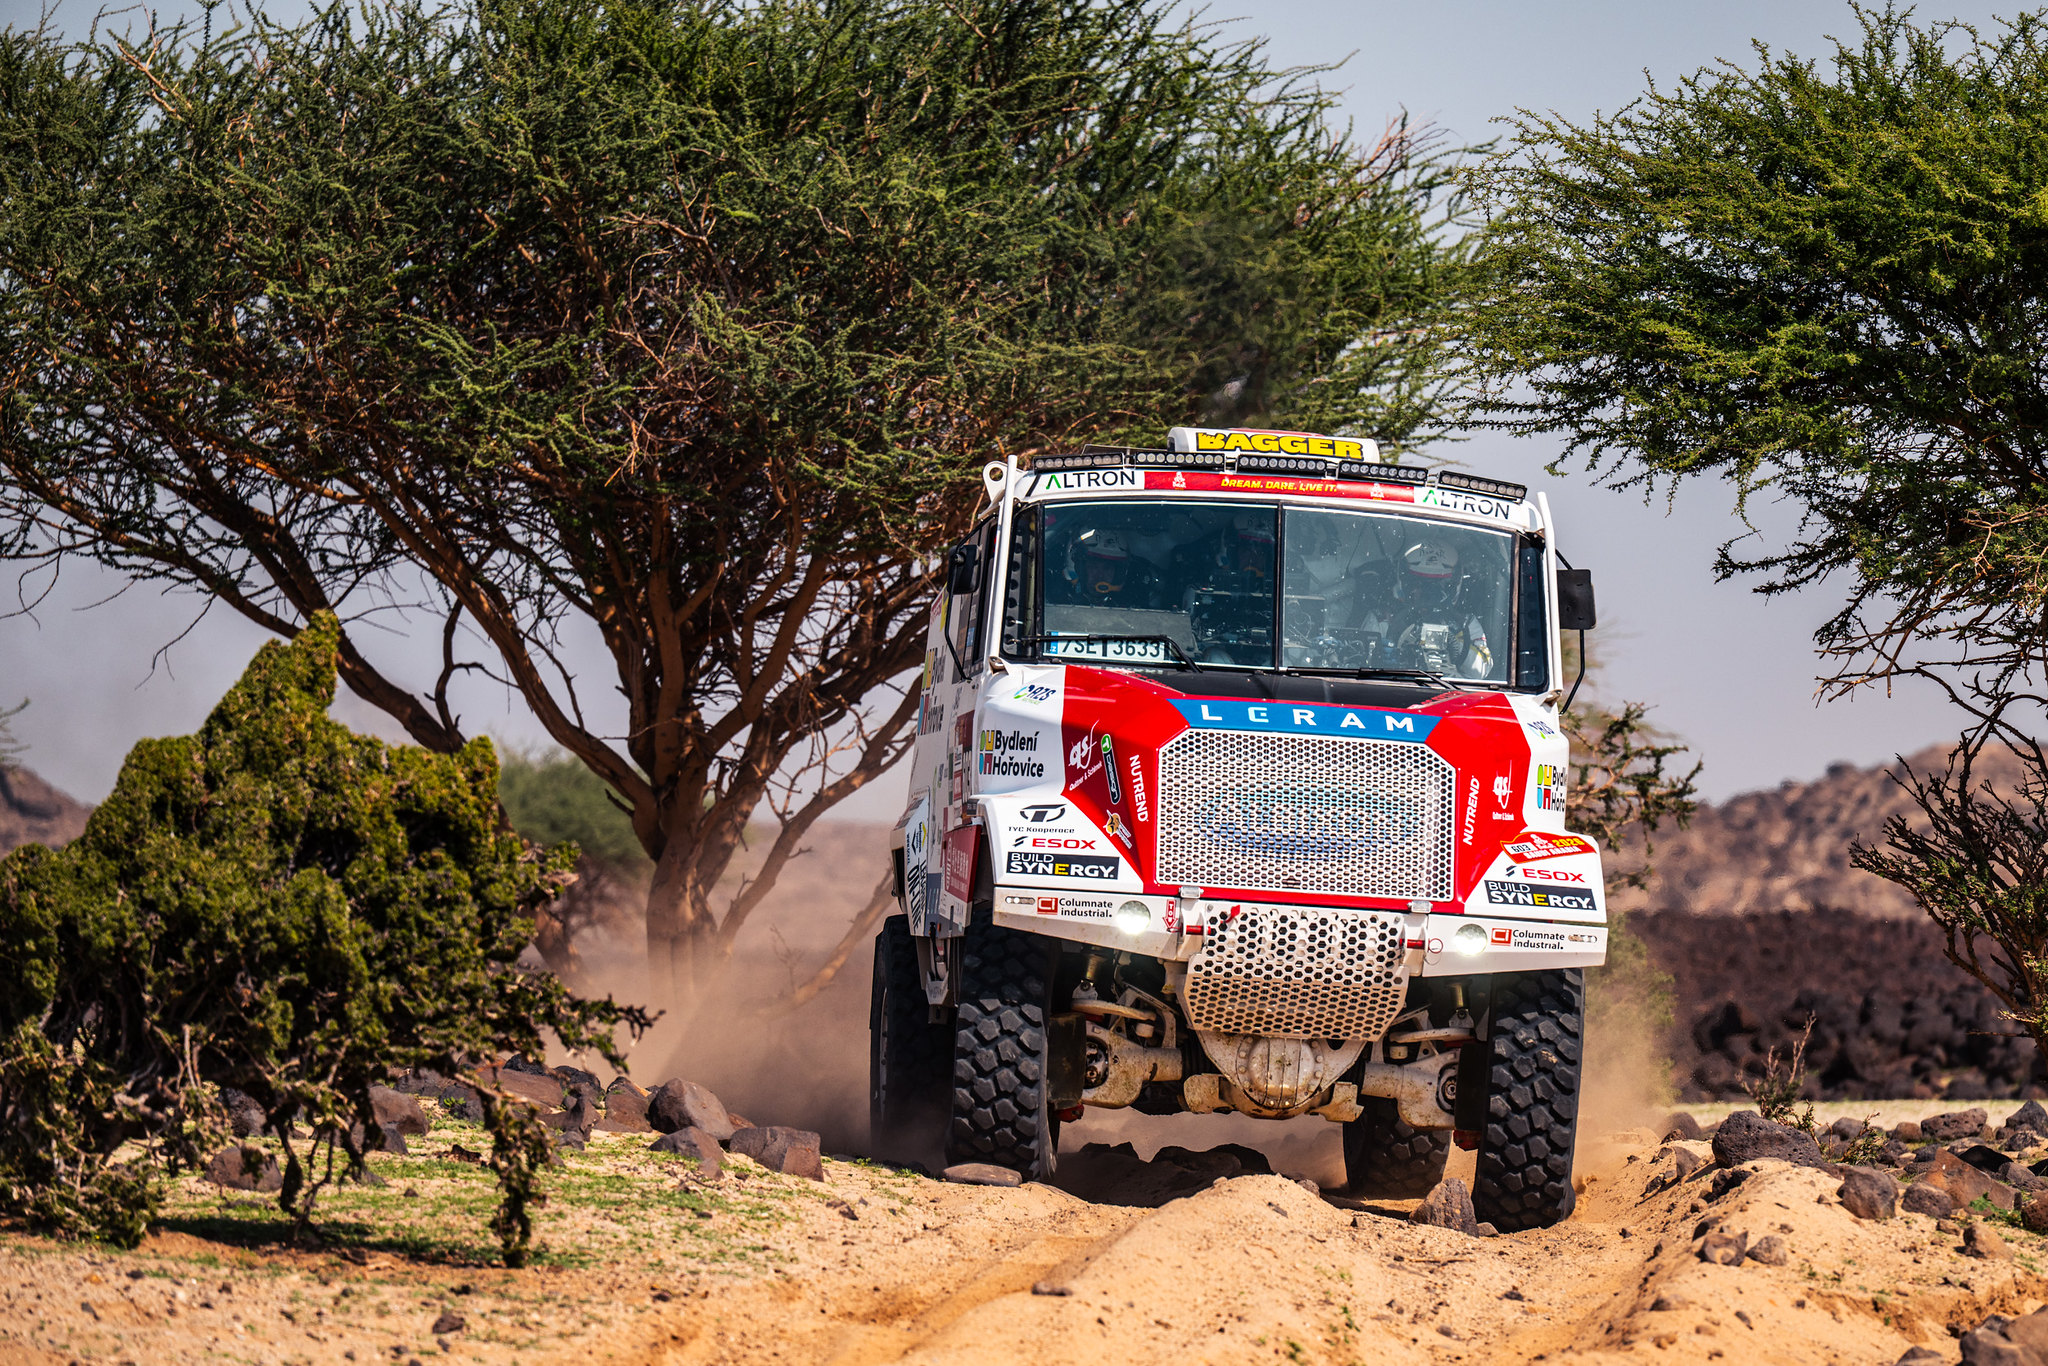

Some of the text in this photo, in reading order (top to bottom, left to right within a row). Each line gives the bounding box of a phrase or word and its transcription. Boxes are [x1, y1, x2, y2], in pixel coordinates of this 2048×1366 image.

[1196, 432, 1364, 460] BAGGER
[1045, 471, 1135, 489] ALTRON
[1221, 479, 1337, 492] DREAM. DARE. LIVE IT.
[1423, 490, 1510, 519] ALTRON
[1113, 639, 1160, 657] 3633
[1201, 704, 1415, 733] LERAM
[994, 730, 1040, 755] Bydlení
[992, 756, 1044, 777] Hořovice
[1129, 754, 1149, 822] NUTREND
[1463, 777, 1480, 846] NUTREND
[1032, 838, 1096, 850] ESOX
[1011, 853, 1054, 863] BUILD
[1522, 868, 1585, 882] ESOX
[1488, 882, 1530, 893] BUILD
[1059, 898, 1113, 908] Columnate
[1061, 908, 1112, 917] industrial.
[1513, 929, 1565, 940] Columnate
[1514, 939, 1564, 950] industrial.
